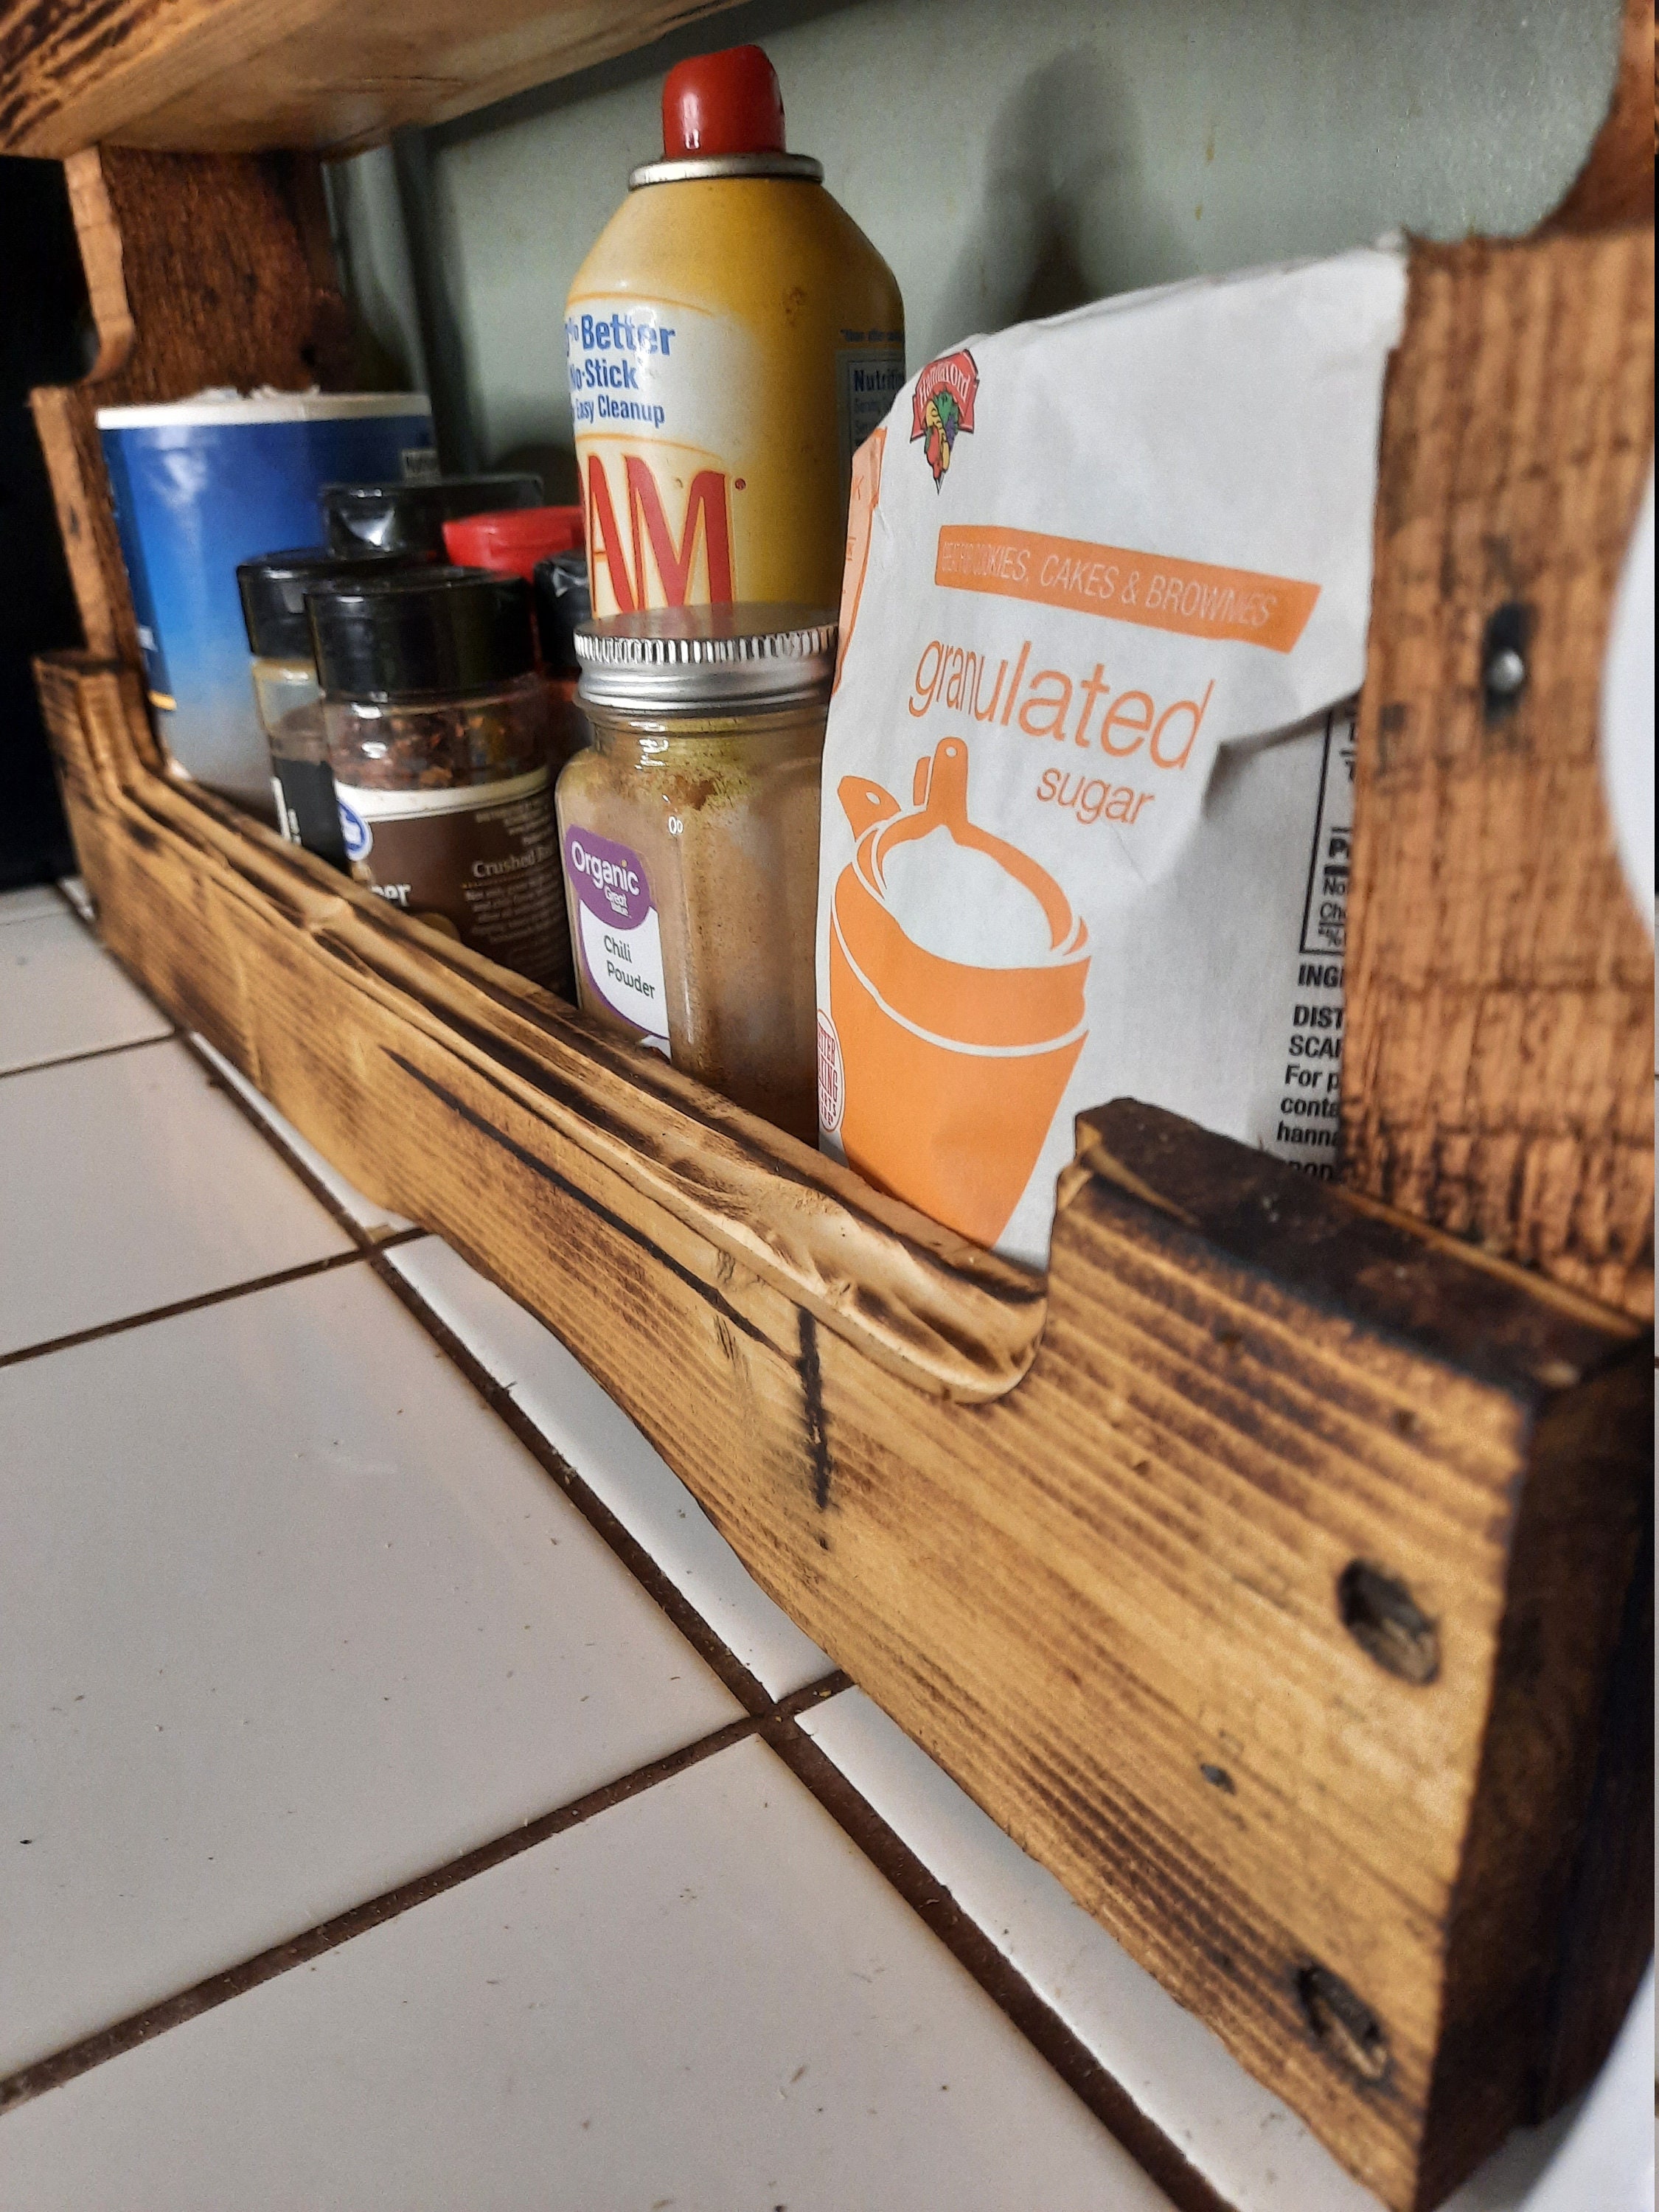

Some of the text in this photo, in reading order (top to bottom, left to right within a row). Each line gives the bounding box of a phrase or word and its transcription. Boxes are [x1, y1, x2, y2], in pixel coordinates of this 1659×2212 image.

[581, 313, 675, 355] Better
[598, 394, 665, 428] Cleanup
[1040, 554, 1119, 599] CAKES
[1121, 570, 1140, 605] &
[1144, 574, 1276, 627] BROWNIES
[908, 640, 1217, 771] granulated
[1036, 767, 1155, 826] sugar
[473, 849, 535, 878] Crushed
[571, 840, 640, 895] Organic
[604, 935, 633, 963] Chili
[606, 960, 655, 999] Powder
[1284, 1064, 1322, 1088] For
